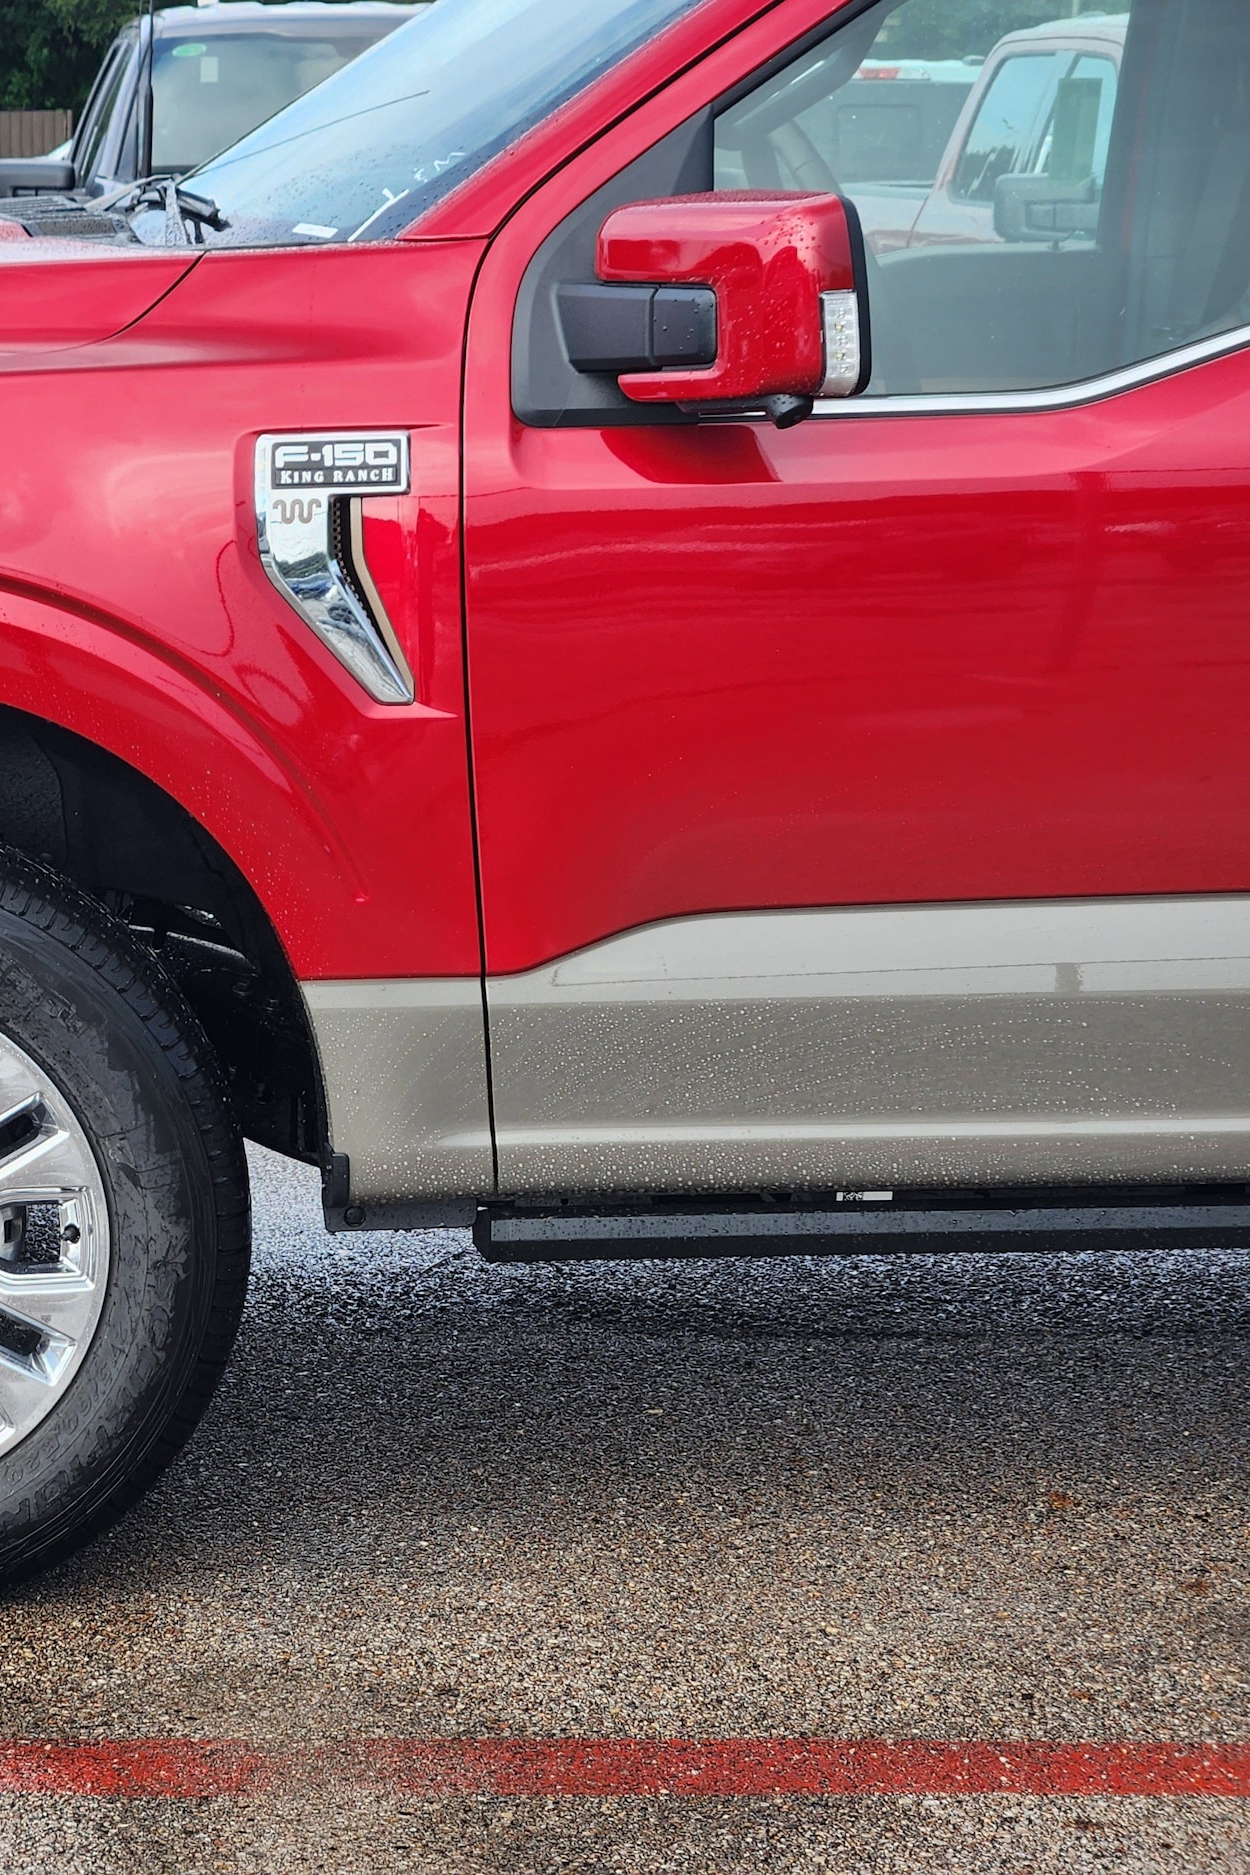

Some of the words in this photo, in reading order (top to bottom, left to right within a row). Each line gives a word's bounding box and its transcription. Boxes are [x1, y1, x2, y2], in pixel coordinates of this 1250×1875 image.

[274, 442, 398, 468] F-150
[280, 470, 324, 484] KING
[333, 468, 394, 482] RANCH
